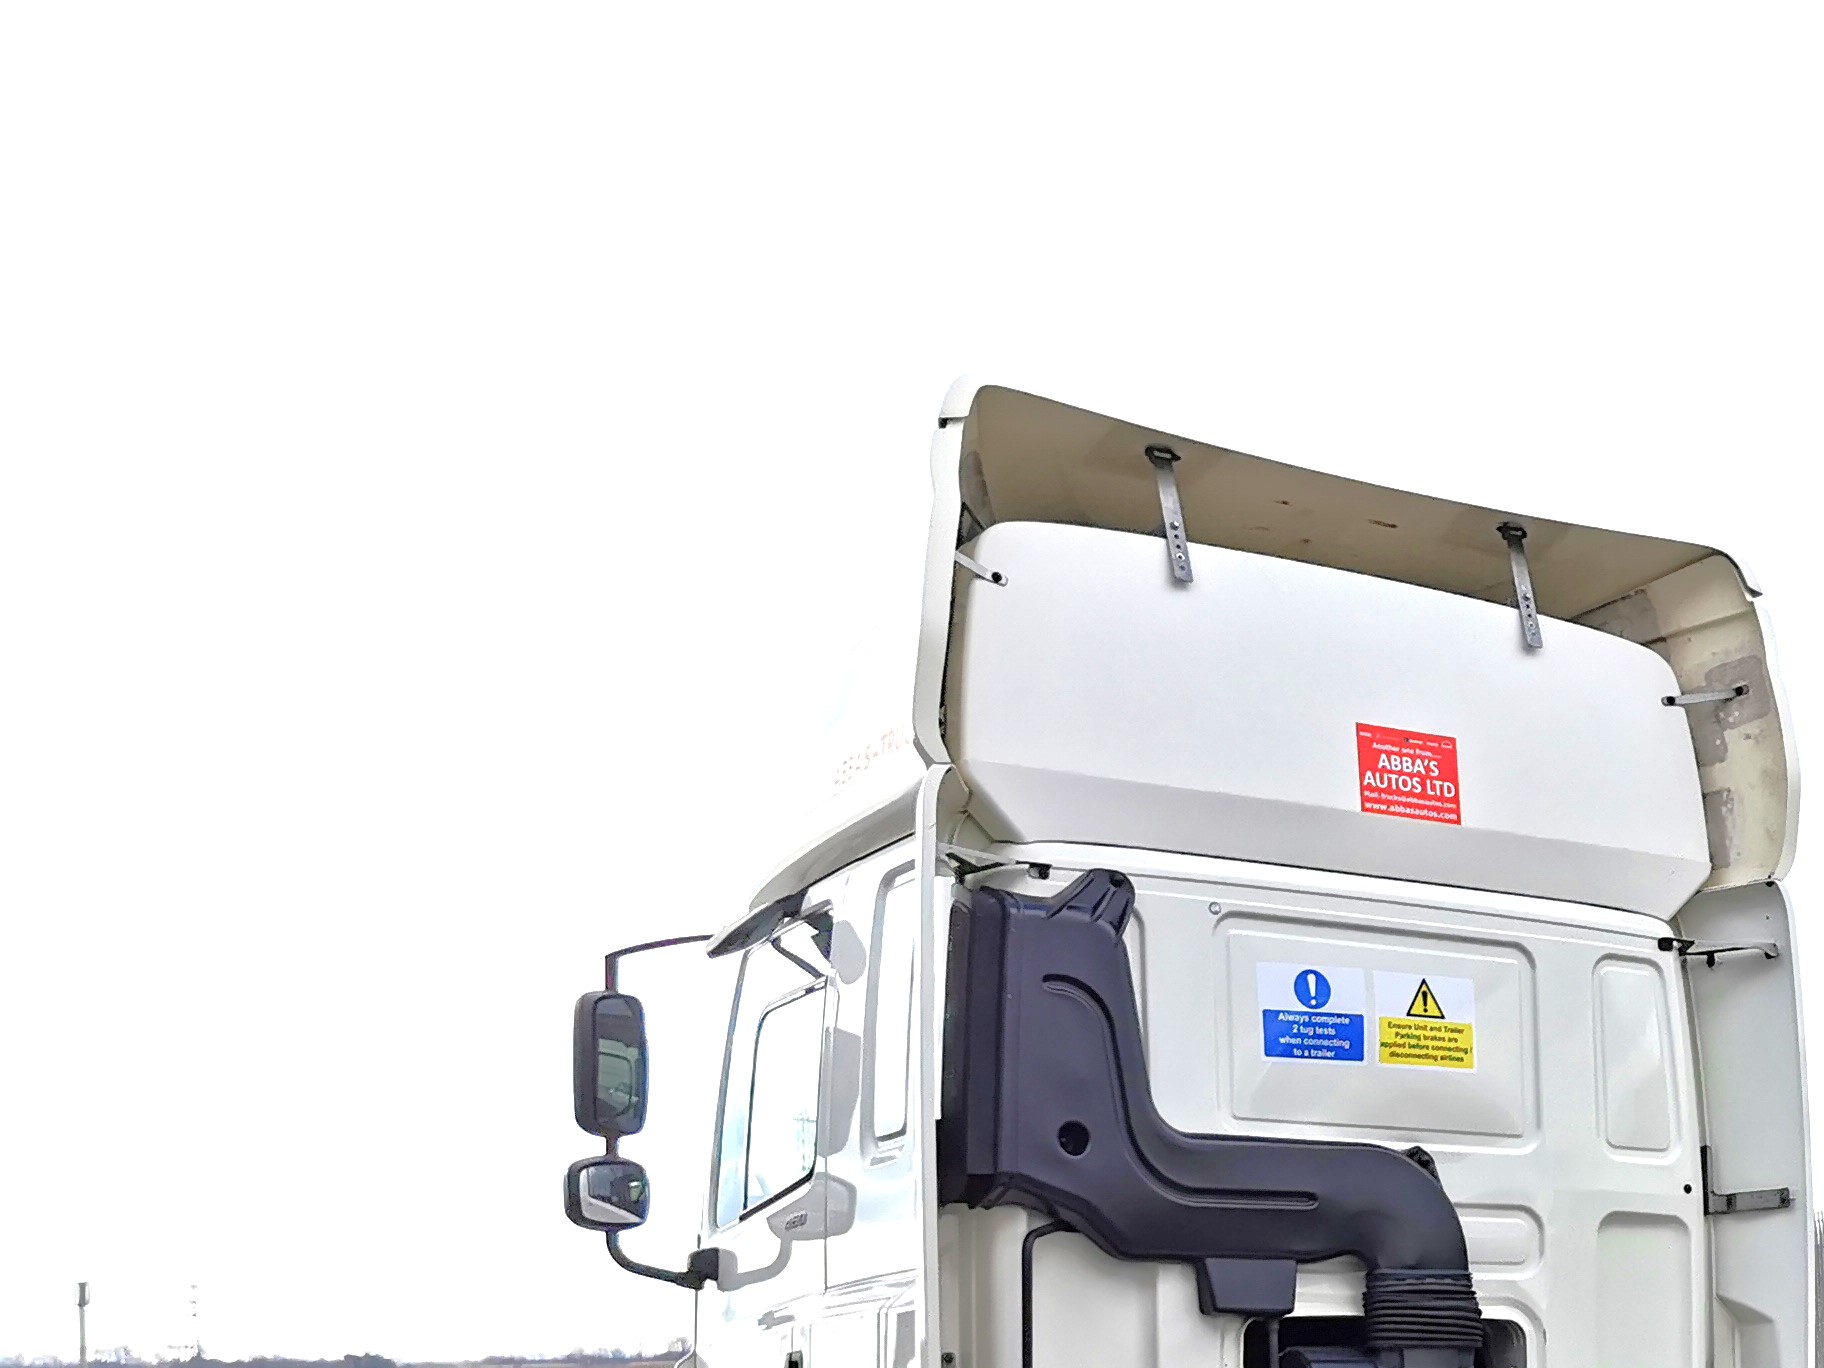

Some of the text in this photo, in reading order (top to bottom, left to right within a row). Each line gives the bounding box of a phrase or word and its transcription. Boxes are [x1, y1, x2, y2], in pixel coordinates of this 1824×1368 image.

[1378, 753, 1439, 777] ABBA'S
[1363, 770, 1456, 798] AUTOS LTD
[1364, 801, 1458, 820] www.abbasautos.com
[1278, 1012, 1350, 1025] Always complete
[1292, 1024, 1336, 1036] 2 tug tests
[1387, 1021, 1412, 1030] Ensure
[1414, 1023, 1428, 1031] Unit
[1429, 1025, 1442, 1033] and
[1278, 1036, 1350, 1050] when connecting
[1394, 1031, 1422, 1041] Parking
[1422, 1033, 1446, 1042] brakes
[1293, 1048, 1302, 1056] to
[1310, 1049, 1335, 1057] trailer
[1407, 1042, 1430, 1051] before
[1431, 1044, 1469, 1055] connecting
[1388, 1050, 1465, 1062] disconnecting airlines
